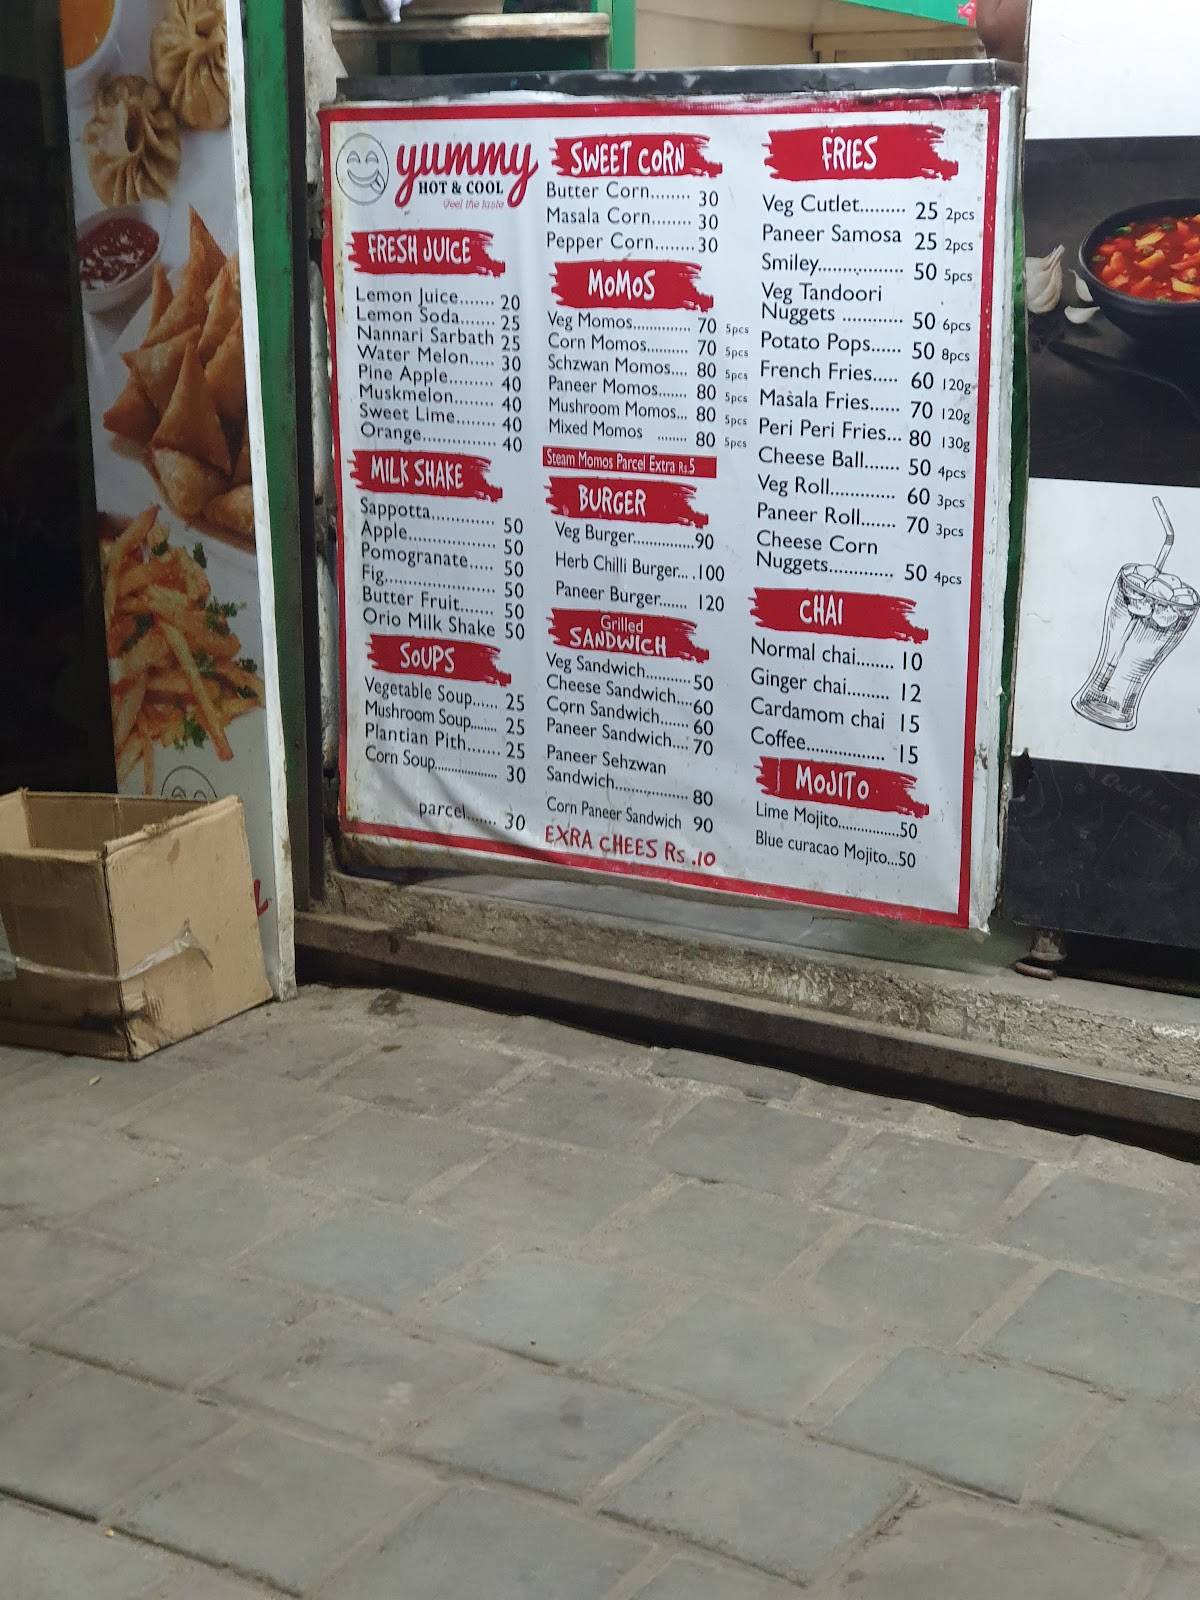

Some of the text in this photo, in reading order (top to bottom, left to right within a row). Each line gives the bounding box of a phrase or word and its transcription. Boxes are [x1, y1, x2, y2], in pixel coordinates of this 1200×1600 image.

[570, 140, 632, 175] SWEET
[821, 135, 878, 171] FRIES
[394, 141, 538, 208] yummy
[418, 180, 503, 195] HOT & COOL
[547, 182, 718, 206] Butter 30
[762, 194, 974, 224] Veg 25 2pcs
[547, 207, 718, 230] Masala 30
[367, 234, 418, 265] FRESH
[547, 232, 718, 254] Pepper 30
[763, 224, 973, 254] Paneer Samosa 25 2pcs
[914, 262, 972, 285] 50 5pcs
[356, 286, 520, 310] Lemon 20
[762, 282, 881, 304] Veg Tandoori
[357, 306, 520, 331] Lemon 25
[548, 311, 748, 336] Veg 70 5pcs
[762, 302, 970, 334] Nuggets 50 6pcs
[358, 325, 520, 351] Nannari Sarbath 25
[548, 332, 748, 360] Corn 70 5pcs
[762, 331, 970, 364] Potato 50 8pcs
[358, 344, 521, 371] Water 30
[549, 354, 748, 382] Schzwan 80 5pcs
[359, 364, 521, 392] Pine 40
[549, 375, 747, 404] Paneer 80 5pcs
[761, 360, 970, 394] French 60 120g
[360, 402, 522, 432] Sweet 40
[549, 397, 746, 427] Mushroom 80 5pcs
[760, 388, 970, 424] Masala 70 120g
[550, 418, 746, 450] Mixed Momos 80 5pcs
[760, 418, 970, 452] Peri Peri 80 130g
[370, 455, 464, 490] MILK SHAKE
[546, 448, 575, 466] Steam
[578, 450, 613, 469] Momos
[616, 452, 646, 472] Parcel
[650, 454, 675, 474] Extra
[759, 446, 966, 481] Cheese 50 4pcs
[578, 484, 647, 517] BURGER
[758, 474, 964, 510] Veg 60 3pcs
[555, 522, 580, 543] Veg
[758, 502, 963, 539] Paneer 70 3pcs
[757, 530, 877, 554] Cheese Corn
[556, 551, 626, 573] Herb Chilli
[904, 564, 961, 587] 50 4pcs
[363, 586, 524, 619] Butter 50
[556, 580, 724, 612] Paneer 120
[363, 608, 524, 640] Orio Milk Shake 50
[600, 615, 644, 634] Grilled
[752, 636, 922, 671] Normal 10
[546, 652, 713, 691] Veg 50
[547, 674, 600, 694] Cheese
[751, 667, 921, 702] Ginger 12
[365, 676, 524, 711] Vegetable 25
[366, 700, 524, 735] Mushroom 25
[547, 696, 713, 735] Corn 60
[751, 696, 919, 733] Cardamom chai 15
[366, 722, 524, 759] Plantian 25
[548, 717, 713, 756] Paneer 70
[366, 746, 525, 784] Corn 30
[548, 744, 597, 764] Paneer
[900, 744, 918, 764] 15
[693, 790, 713, 806] 80
[756, 801, 788, 820] Lime
[547, 796, 713, 833] Corn Paneer Sandwich 90
[544, 824, 593, 850] EXRA
[756, 830, 838, 856] Blue curacao
